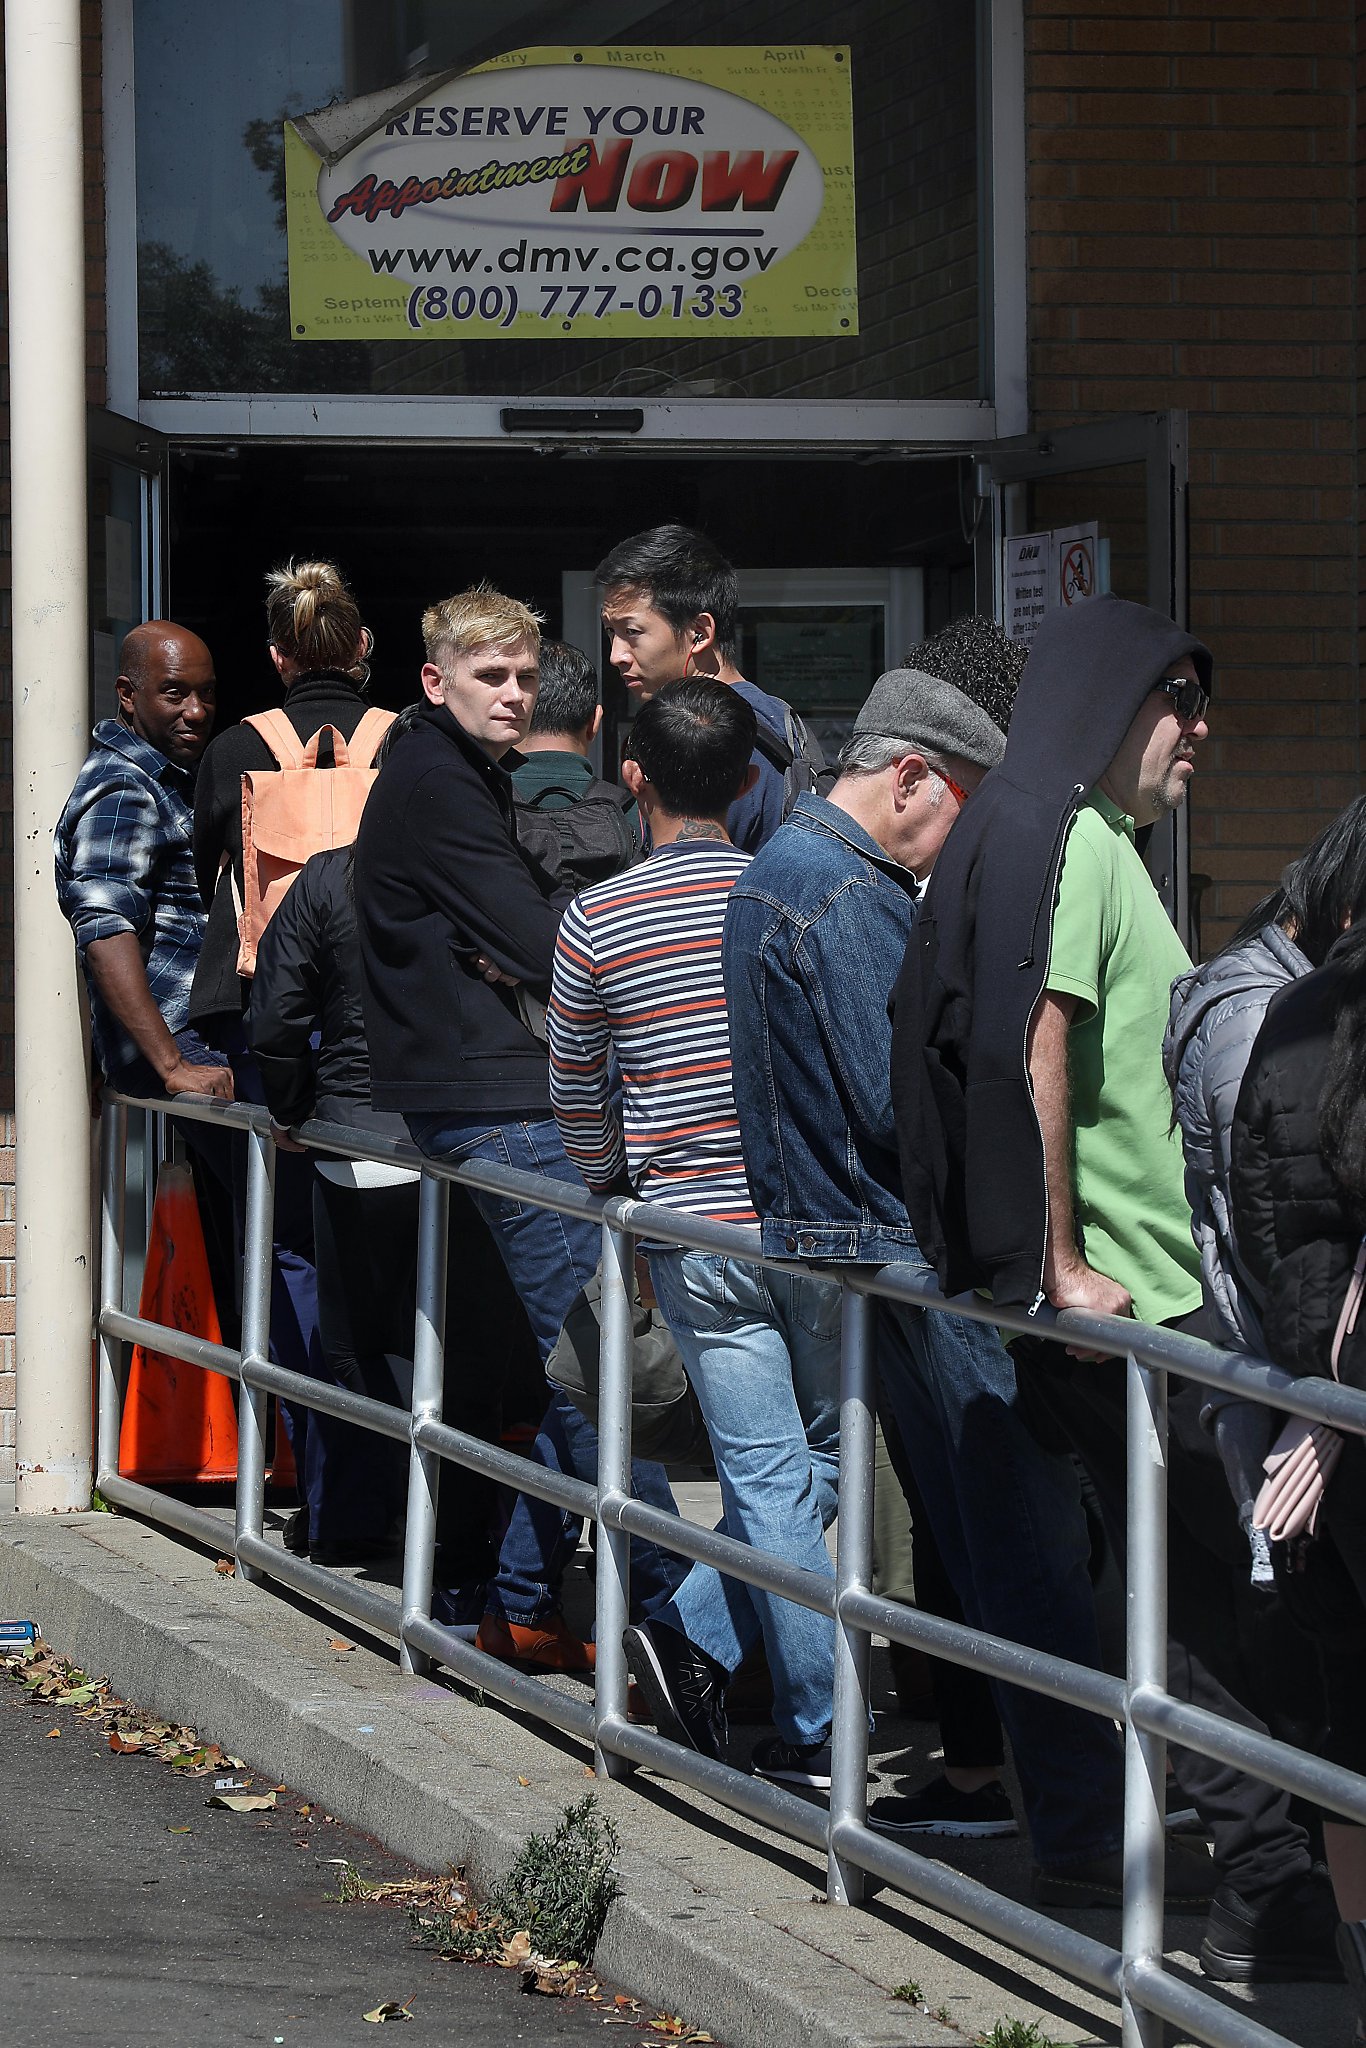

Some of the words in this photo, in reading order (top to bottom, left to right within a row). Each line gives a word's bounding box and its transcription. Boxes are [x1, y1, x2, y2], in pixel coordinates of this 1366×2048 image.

[606, 51, 666, 62] March
[763, 50, 806, 63] April
[384, 105, 569, 136] RESERVE
[583, 105, 706, 136] YOUR
[327, 142, 592, 223] Appointment
[368, 239, 779, 281] www.dmv.ca.gov
[408, 285, 519, 328] (800)
[540, 284, 743, 319] 777-0133
